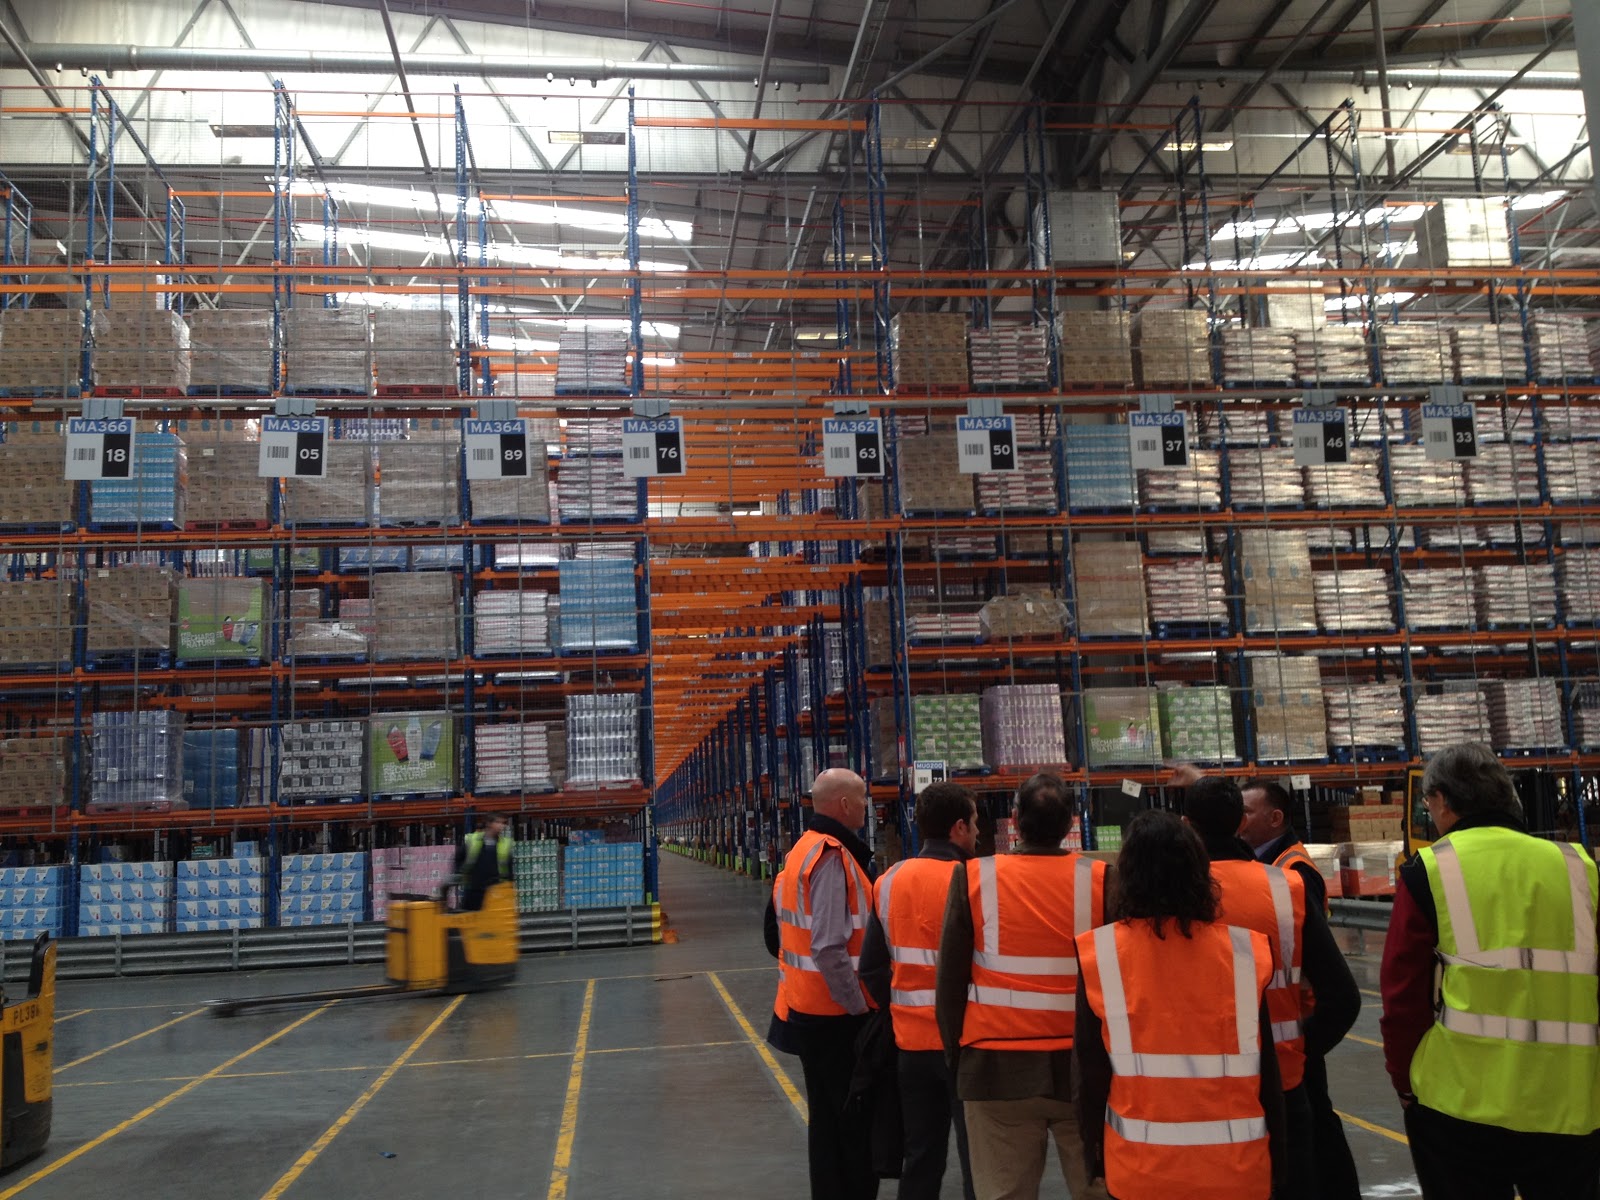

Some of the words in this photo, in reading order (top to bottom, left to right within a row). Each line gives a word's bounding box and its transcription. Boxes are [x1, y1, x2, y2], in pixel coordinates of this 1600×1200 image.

[1297, 411, 1342, 422] MA359
[1426, 405, 1469, 417] MA358
[267, 418, 321, 431] MA365
[964, 418, 1007, 429] MA361
[1134, 414, 1181, 425] MA360
[73, 420, 128, 432] MA366
[471, 421, 522, 433] MA364
[627, 421, 676, 432] MA363
[828, 421, 875, 432] MA362
[1326, 437, 1344, 448] 46
[1455, 432, 1472, 443] 33
[993, 445, 1011, 456] 50
[1165, 440, 1182, 452] 37
[106, 448, 126, 462] 18
[299, 448, 320, 460] 05
[504, 449, 523, 461] 89
[659, 447, 678, 459] 76
[859, 448, 877, 459] 63
